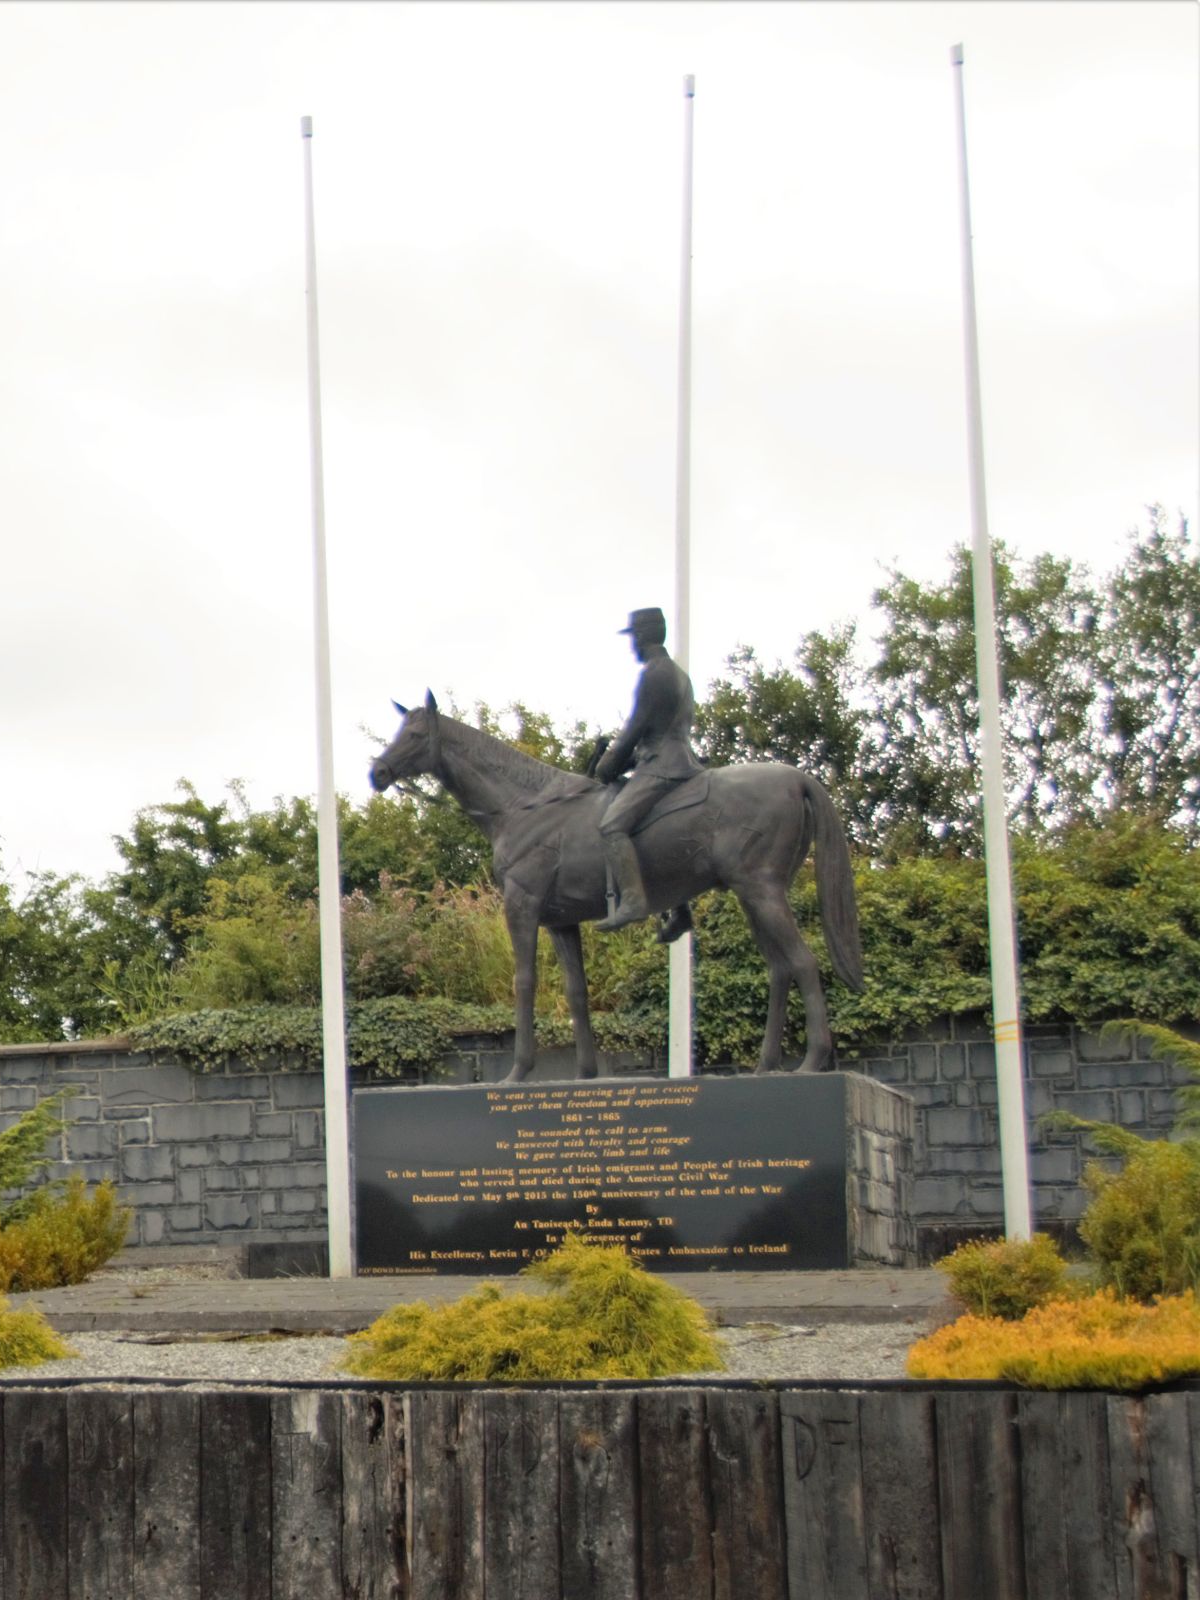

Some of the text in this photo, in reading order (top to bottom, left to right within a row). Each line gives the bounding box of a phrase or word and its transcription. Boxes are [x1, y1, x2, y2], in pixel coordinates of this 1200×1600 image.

[574, 1088, 613, 1098] starving
[617, 1086, 636, 1096] and
[489, 1104, 508, 1114] you
[511, 1104, 534, 1112] gave
[568, 1100, 607, 1108] freedom
[612, 1098, 630, 1106] and
[634, 1096, 694, 1108] opportunity
[561, 1114, 582, 1122] 1861
[598, 1112, 620, 1120] 1865
[518, 1129, 535, 1138] You
[540, 1128, 581, 1136] sounded
[585, 1127, 600, 1136] the
[604, 1126, 624, 1134] call
[514, 1140, 560, 1148] answered
[564, 1139, 584, 1147] with
[589, 1138, 622, 1148] loyalty
[627, 1136, 646, 1144] and
[650, 1136, 690, 1146] courage
[532, 1152, 556, 1162] gave
[602, 1148, 625, 1157] limb
[630, 1148, 648, 1156] and
[653, 1147, 670, 1156] life
[385, 1158, 810, 1178] To the honour and lasting memory of Irish emigrants and People of Irish heritage
[460, 1172, 728, 1188] who served and died during the American Civil War
[412, 1194, 458, 1203] Dedicated
[482, 1193, 501, 1203] May
[524, 1192, 547, 1200] 2015
[552, 1190, 567, 1199] the
[602, 1190, 660, 1198] anniversary
[664, 1188, 676, 1196] of
[680, 1188, 696, 1196] the
[700, 1187, 720, 1195] end
[724, 1186, 736, 1194] of
[740, 1186, 756, 1194] the
[762, 1185, 782, 1194] War
[586, 1204, 598, 1215] By
[514, 1220, 527, 1229] An
[588, 1218, 612, 1228] Enda
[618, 1218, 652, 1228] Kenny,
[656, 1217, 672, 1226] TD
[546, 1234, 556, 1242] In
[583, 1234, 626, 1244] presence
[630, 1232, 641, 1241] of
[410, 1251, 426, 1260] His
[431, 1250, 484, 1260] Excellency,
[489, 1249, 517, 1258] Kevin
[632, 1246, 660, 1256] States
[668, 1246, 728, 1255] Ambassador
[734, 1246, 743, 1254] to
[749, 1244, 787, 1254] Ireland
